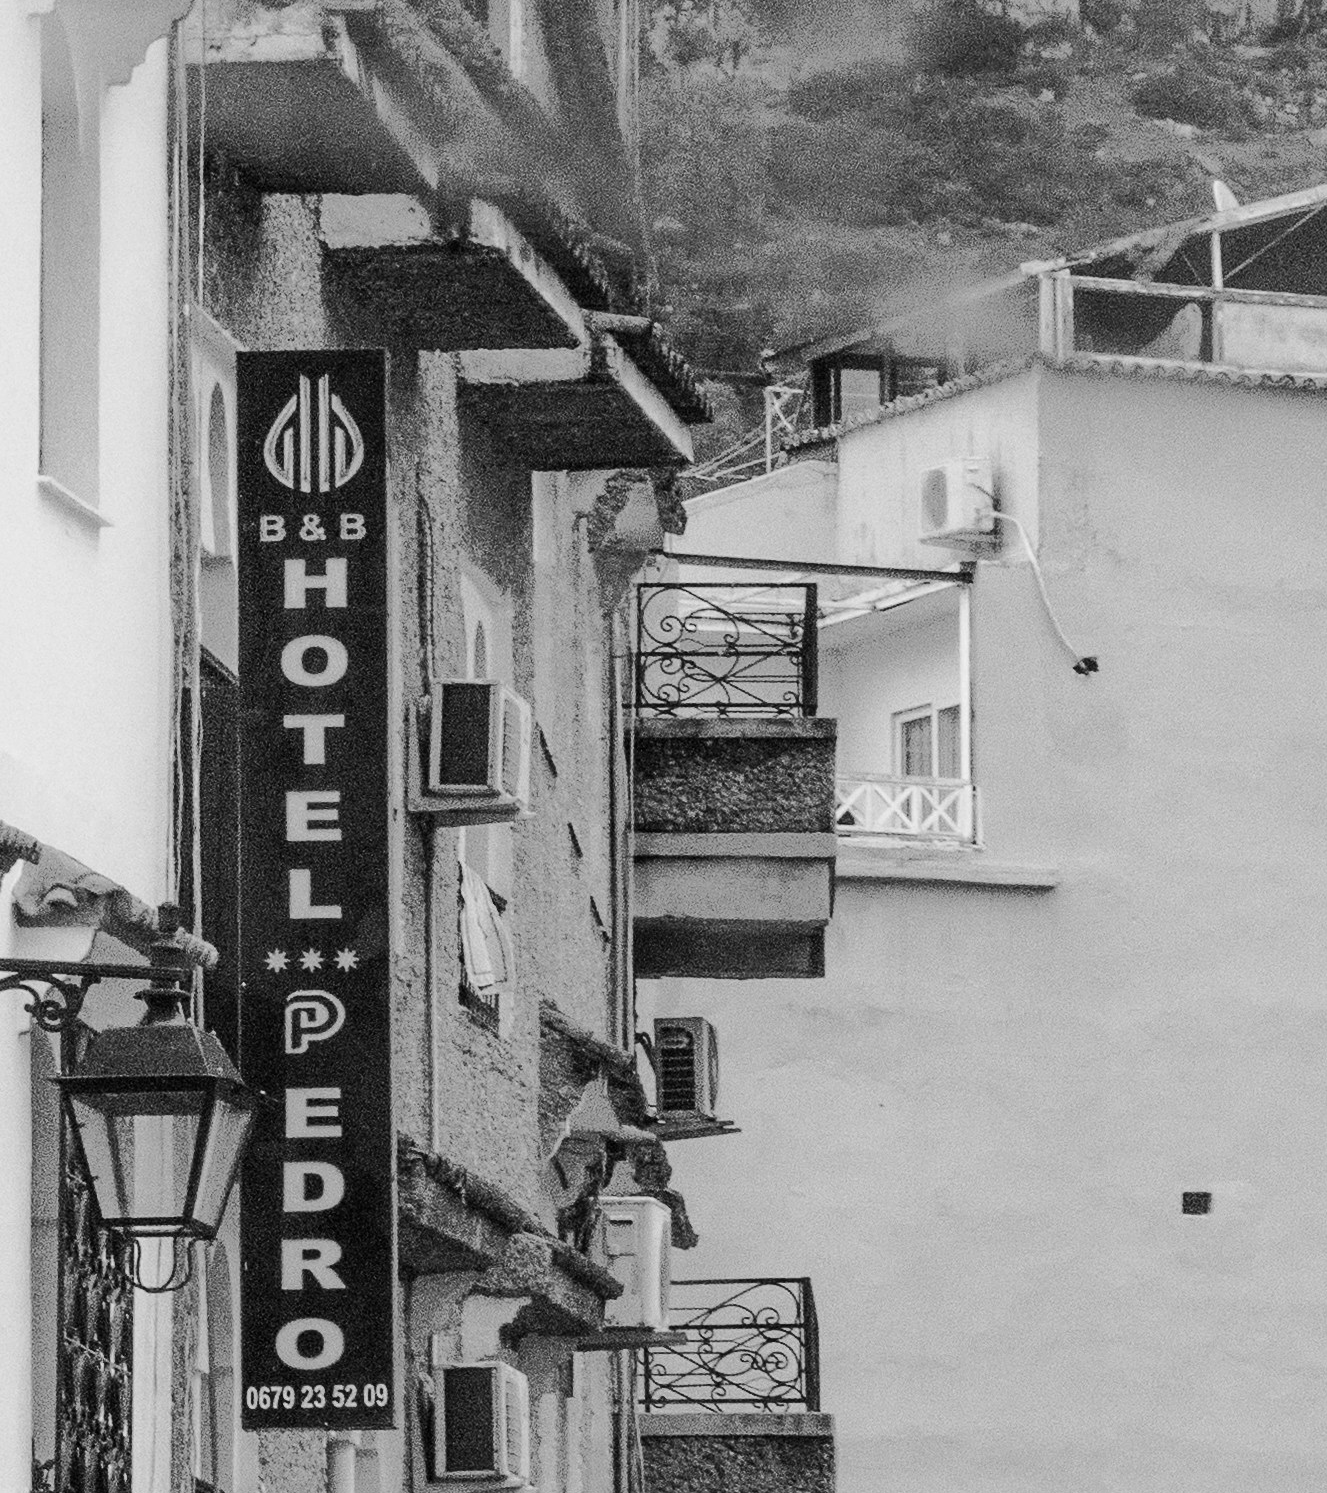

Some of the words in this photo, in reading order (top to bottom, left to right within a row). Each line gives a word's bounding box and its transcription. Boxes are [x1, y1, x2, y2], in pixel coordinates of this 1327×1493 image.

[280, 557, 349, 919] HOTEL
[275, 989, 347, 1370] PEDRO
[246, 1386, 297, 1410] 0679
[300, 1385, 326, 1408] 23
[332, 1384, 358, 1408] 52
[362, 1383, 389, 1407] 09
